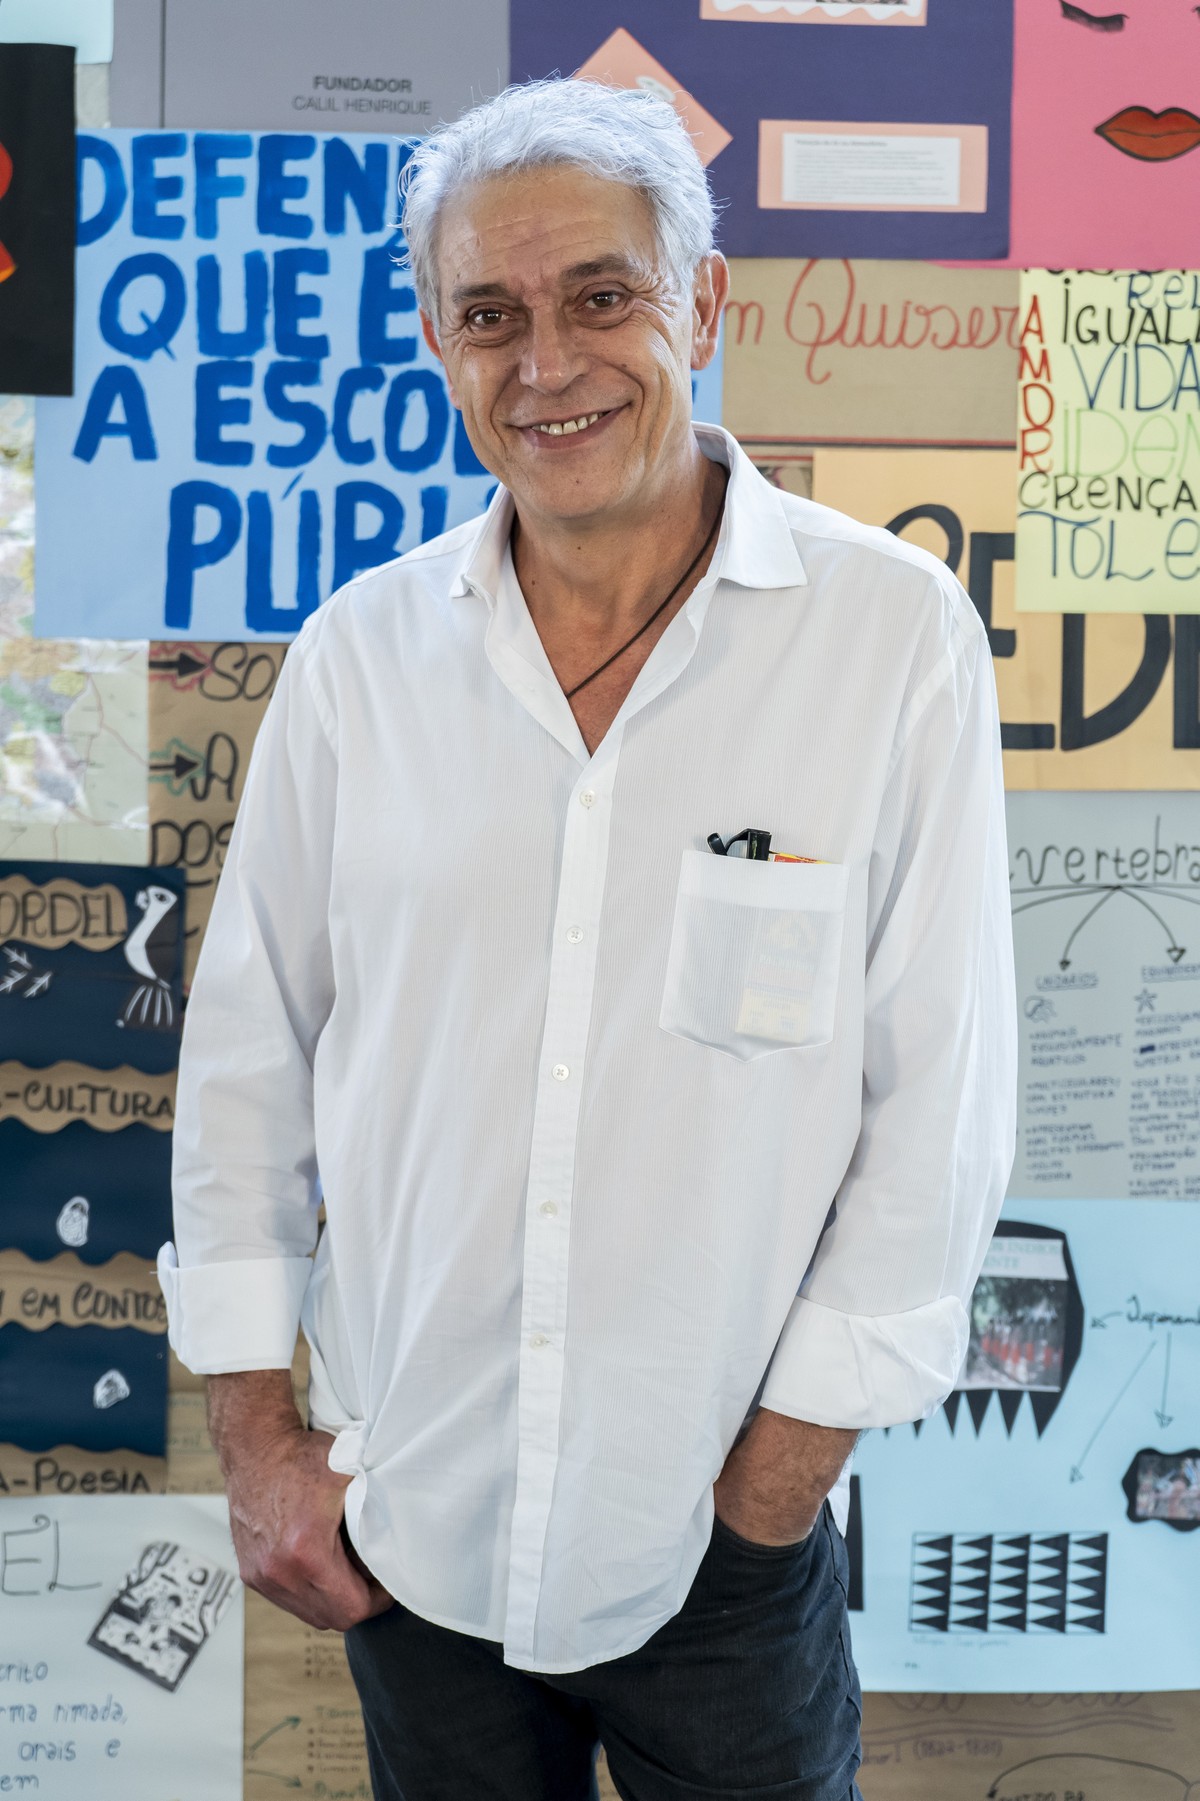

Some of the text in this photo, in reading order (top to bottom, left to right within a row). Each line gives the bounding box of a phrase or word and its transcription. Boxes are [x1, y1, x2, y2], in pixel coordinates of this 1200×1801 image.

[291, 95, 432, 115] CALIL HENRIQUE
[312, 75, 413, 93] FUNDADOR
[76, 133, 425, 246] DEFEN
[99, 249, 331, 361] QUE
[1060, 277, 1200, 345] iGUAL
[72, 364, 158, 465] A
[198, 641, 287, 702] SO
[1009, 814, 1200, 886] vertebra
[0, 1081, 174, 1118] -CULTURA
[18, 1738, 121, 1763] orais e
